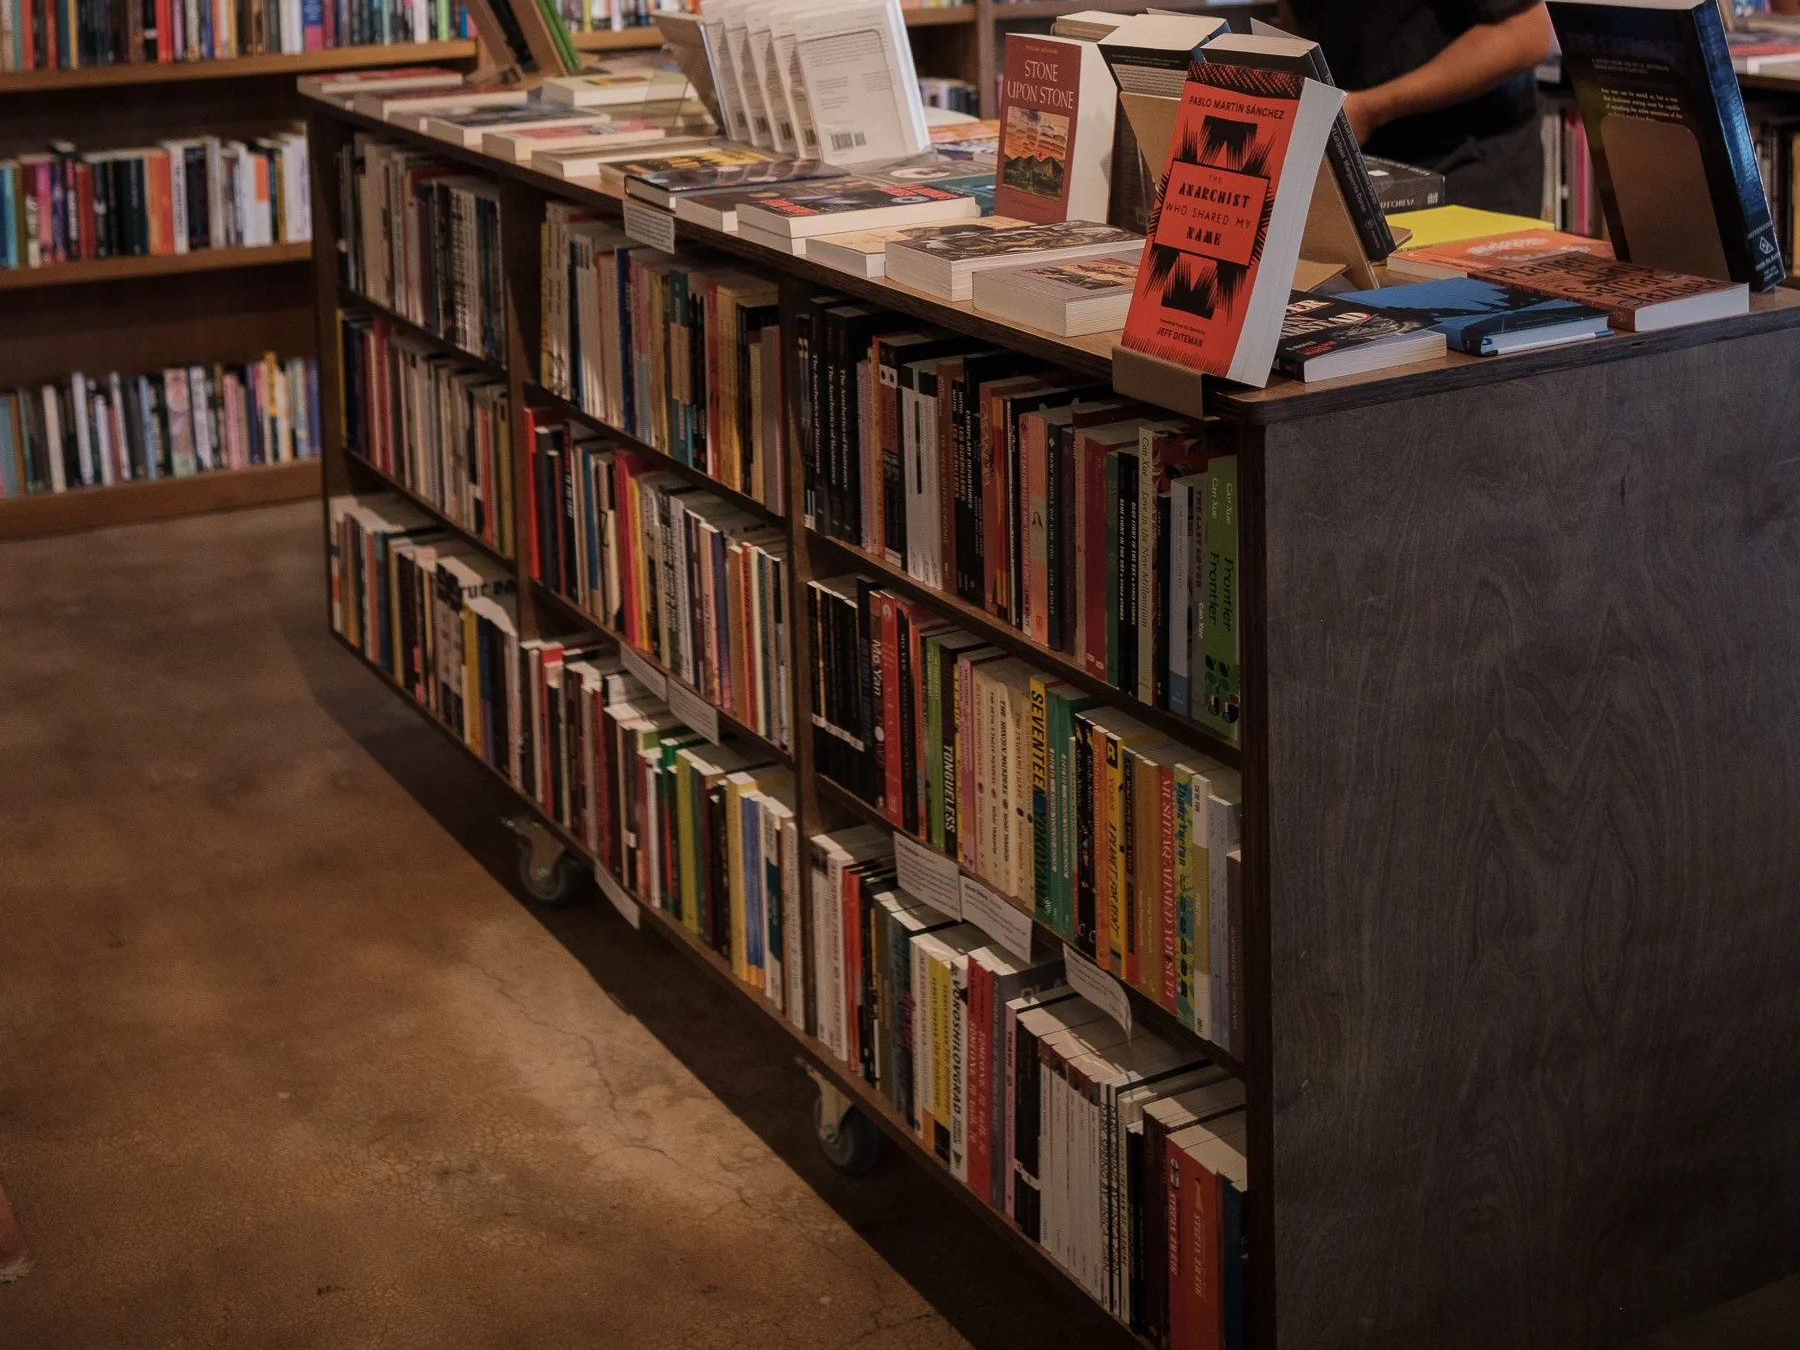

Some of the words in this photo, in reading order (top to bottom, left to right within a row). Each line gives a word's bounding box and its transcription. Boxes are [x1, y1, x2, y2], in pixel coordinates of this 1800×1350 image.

[1024, 59, 1058, 83] STONE
[1006, 80, 1037, 104] UPON
[1039, 86, 1074, 109] STONE
[1188, 95, 1212, 108] PABLO
[1213, 97, 1244, 112] MARTÍN
[1246, 103, 1285, 120] SÁNCHEZ
[1342, 159, 1361, 193] Marguerite
[1178, 182, 1250, 209] ANARCHIST
[1166, 201, 1187, 216] WHO
[1192, 207, 1230, 226] SHARED
[1235, 216, 1252, 229] MY
[1186, 225, 1222, 246] NAME
[1157, 327, 1173, 338] JEFF
[1173, 331, 1204, 347] DITEMAN
[1141, 436, 1149, 456] Can
[1141, 456, 1149, 478] Xue
[1141, 490, 1149, 512] Love
[1141, 514, 1149, 524] in
[1141, 526, 1149, 542] the
[1141, 546, 1149, 568] New
[1141, 570, 1149, 628] Millennium
[1208, 550, 1219, 626] Frontier
[1223, 556, 1234, 632] Frontier
[871, 638, 882, 664] Mo
[871, 668, 882, 696] Yan
[1032, 690, 1046, 802] SEVENTEEN
[943, 744, 955, 834] TONGUELESS
[1177, 782, 1188, 818] Zhang
[1161, 776, 1173, 858] MUSHTAQ
[1108, 832, 1119, 876] PLANET
[1177, 820, 1188, 866] Yueran
[1109, 878, 1118, 902] FOR
[1162, 862, 1174, 924] AHMED
[1109, 904, 1120, 938] RENT
[1164, 926, 1175, 1000] YOUSUFI
[952, 980, 961, 1116] VOROSHILOVGRAD
[1169, 1190, 1177, 1232] STEFAN
[1194, 1212, 1202, 1254] STEFAN
[1169, 1234, 1178, 1276] ZWEIG
[1194, 1256, 1202, 1298] ZWEIG
